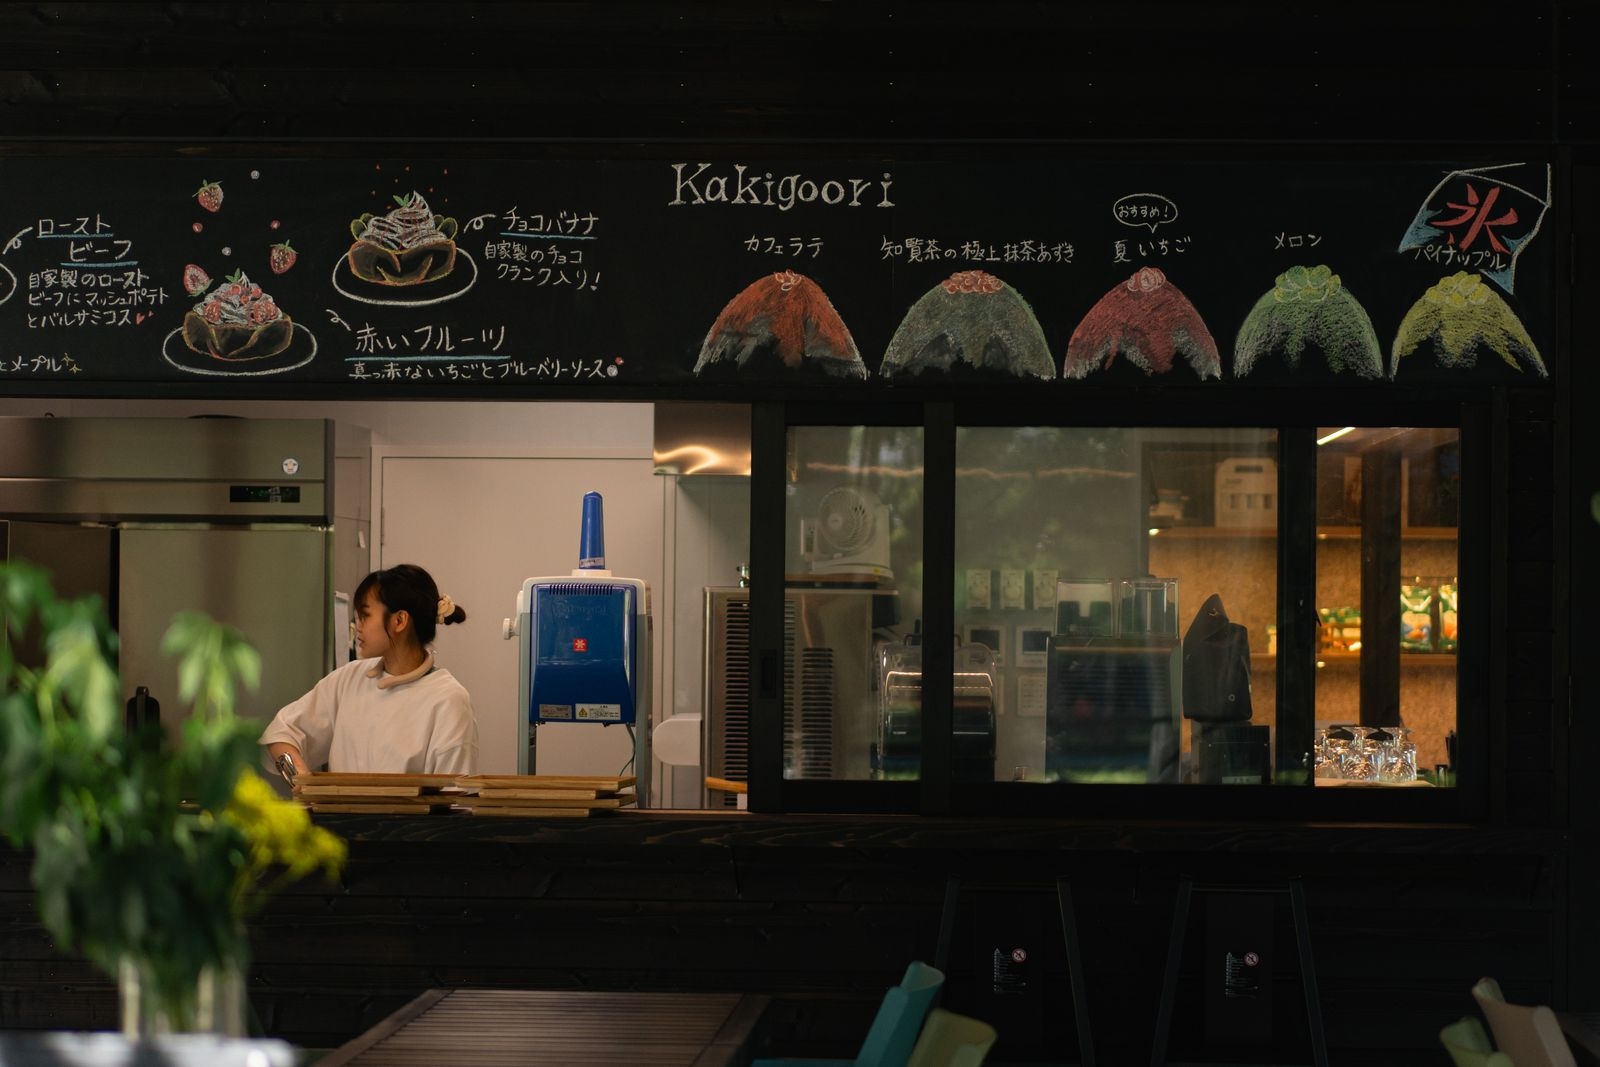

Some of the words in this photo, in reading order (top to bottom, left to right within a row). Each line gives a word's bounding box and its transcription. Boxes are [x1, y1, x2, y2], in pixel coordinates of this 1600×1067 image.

[668, 163, 895, 211] Kakigoori
[38, 213, 112, 236] ロースト
[503, 205, 600, 235] チョコバナナ
[1430, 183, 1519, 255] 氷
[69, 239, 132, 263] ビーフ
[484, 239, 583, 265] 自家製のチョコ
[743, 235, 825, 258] カフェラテ
[1274, 231, 1322, 250] メロン
[1414, 243, 1507, 270] パイナップル
[28, 267, 150, 290] 自家製のロースト
[28, 287, 169, 307] ビーフにマッシュポテト
[27, 309, 132, 329] とバルサミコス
[355, 323, 506, 353] 赤いフルーツ
[349, 358, 606, 380] 真っ赤ないちごとブルーベリーソース
